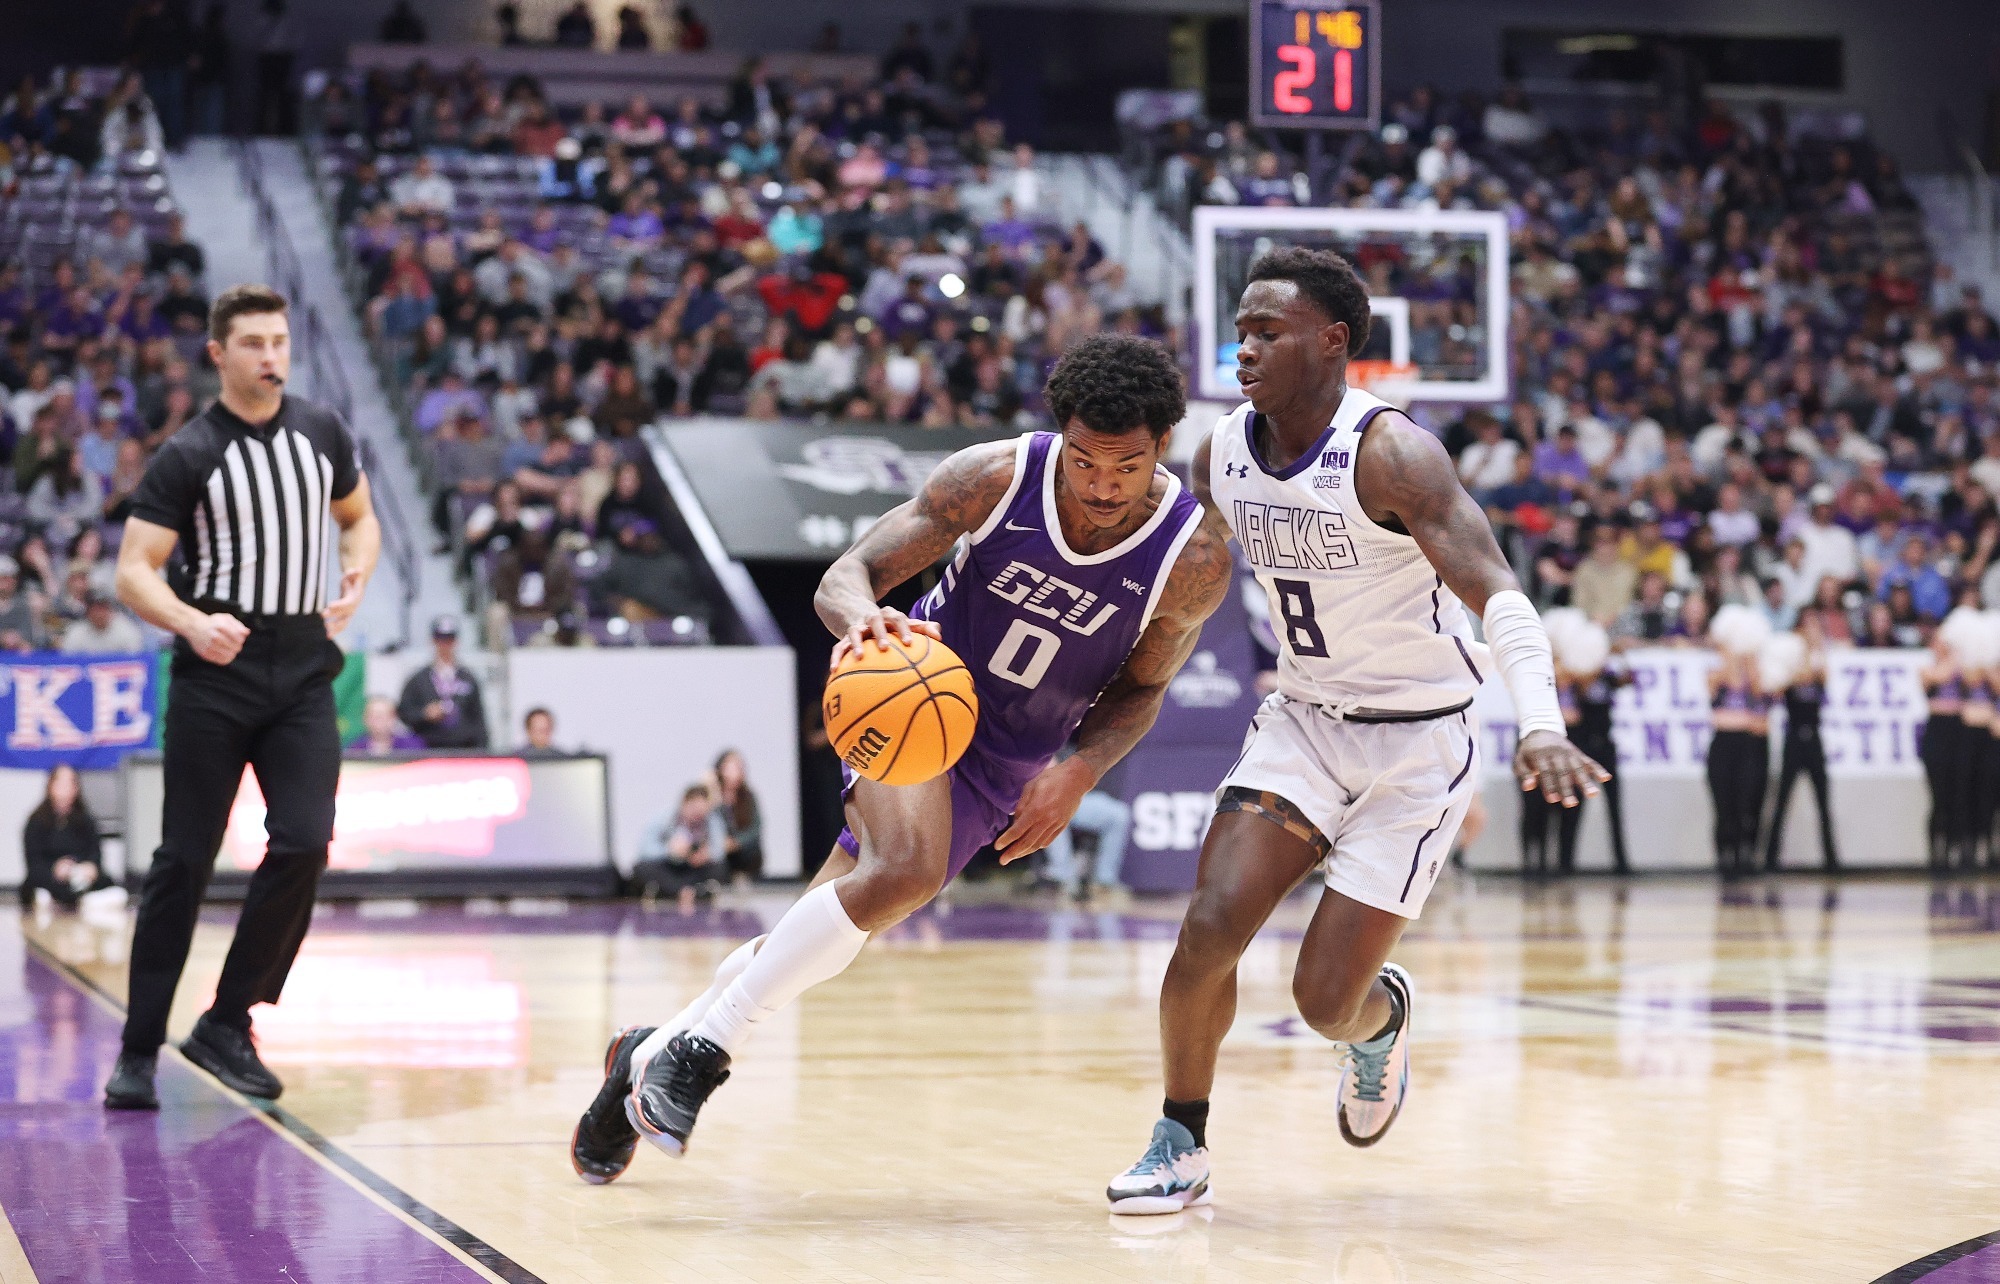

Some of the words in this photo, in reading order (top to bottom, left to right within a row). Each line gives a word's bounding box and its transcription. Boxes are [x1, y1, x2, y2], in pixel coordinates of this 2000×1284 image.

[1274, 45, 1352, 113] 21
[1312, 475, 1341, 489] WAC
[1233, 500, 1359, 570] JACKS
[986, 560, 1121, 637] GCU
[1122, 576, 1146, 596] WAC
[1273, 577, 1331, 658] 8
[987, 618, 1062, 690] 0
[0, 661, 152, 751] KE
[1132, 790, 1217, 851] SF
